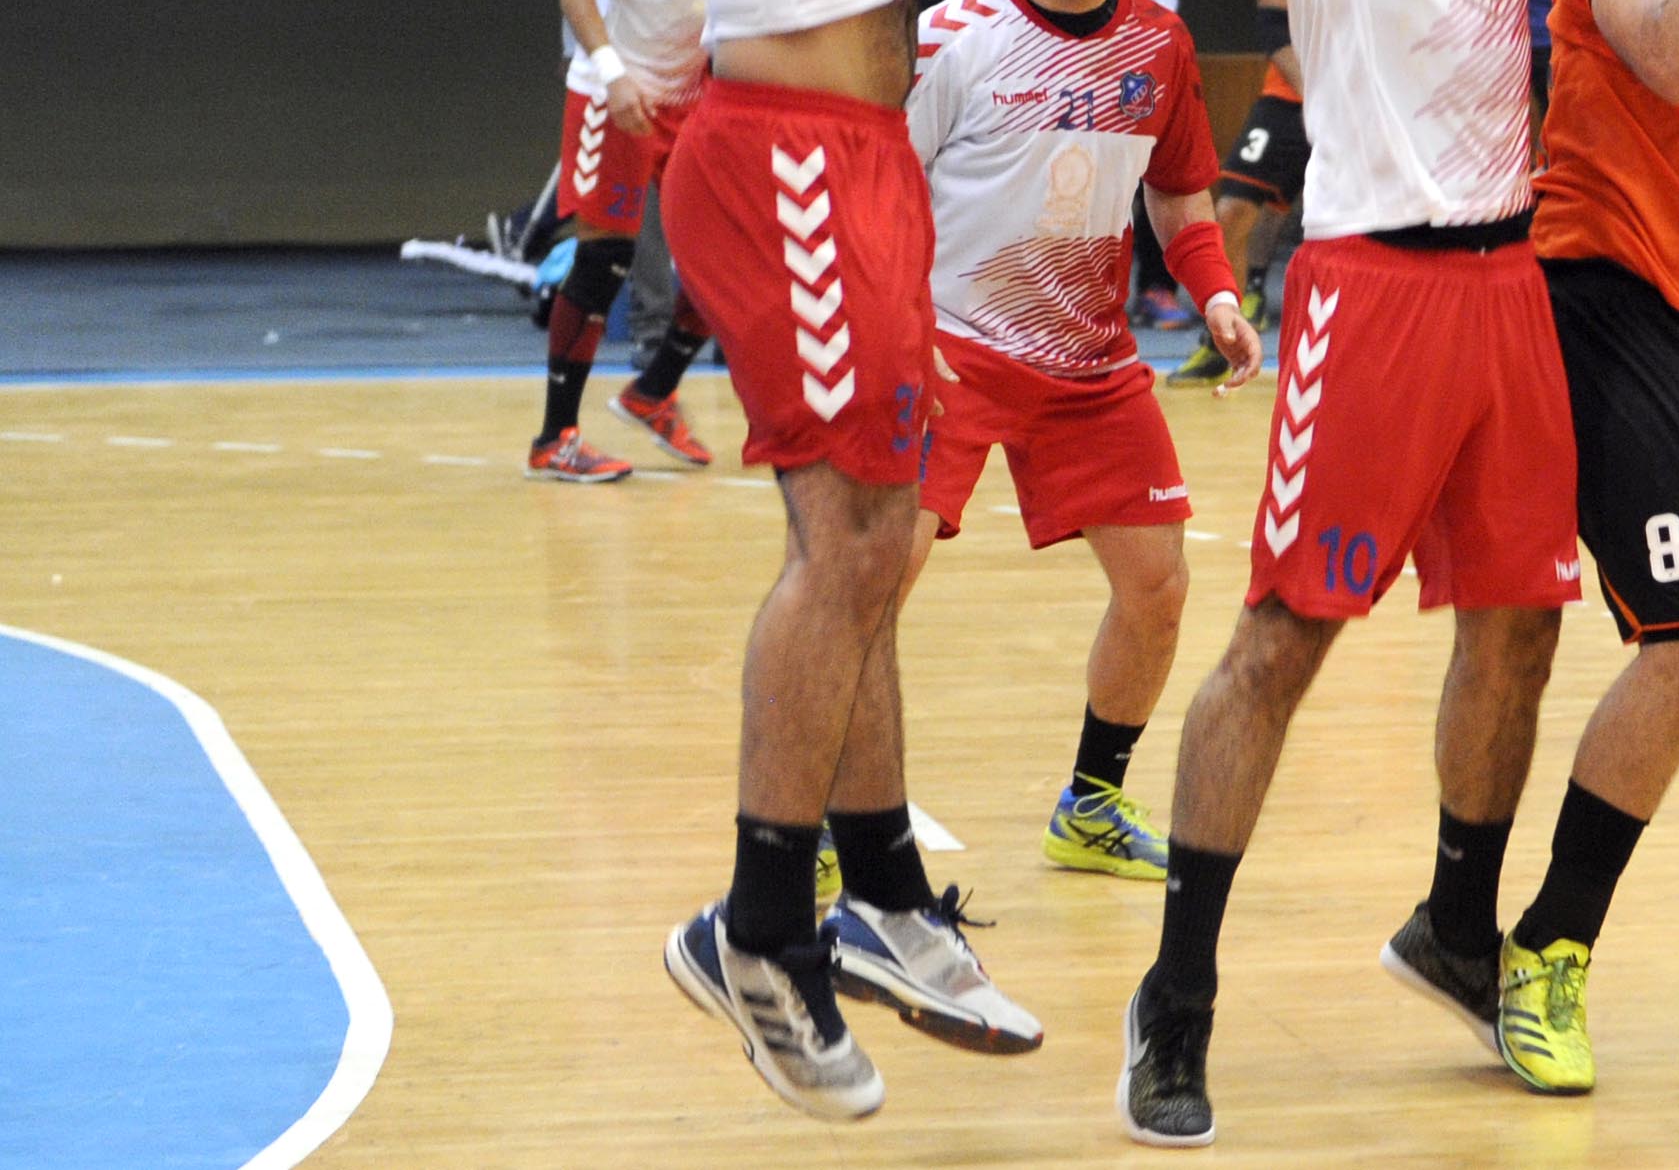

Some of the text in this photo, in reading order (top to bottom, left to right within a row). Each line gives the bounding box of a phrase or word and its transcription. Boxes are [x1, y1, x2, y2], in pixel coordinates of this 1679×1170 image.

[1053, 88, 1096, 131] 21
[1239, 127, 1270, 163] 3
[1318, 525, 1378, 596] 10
